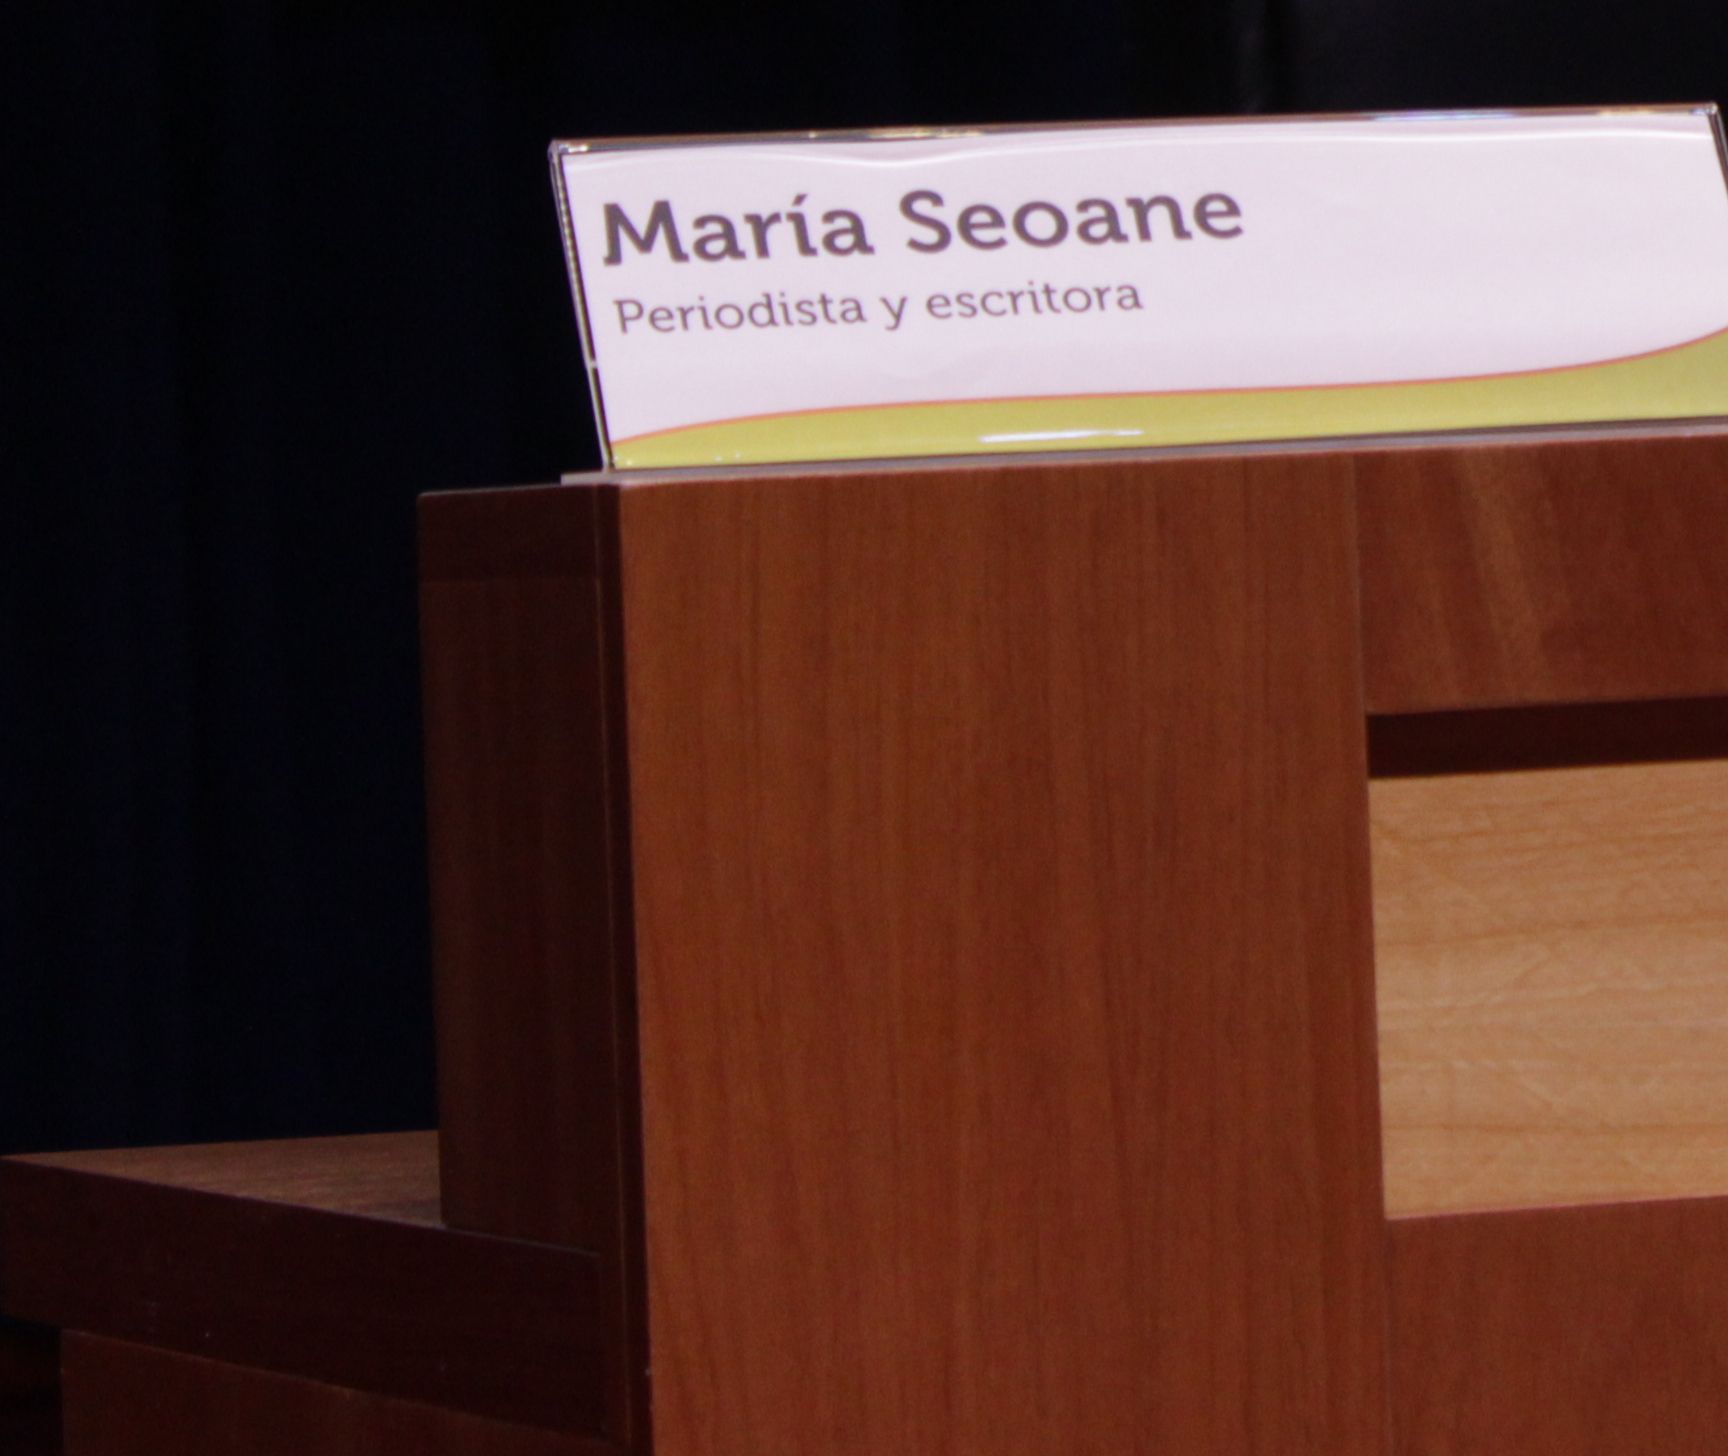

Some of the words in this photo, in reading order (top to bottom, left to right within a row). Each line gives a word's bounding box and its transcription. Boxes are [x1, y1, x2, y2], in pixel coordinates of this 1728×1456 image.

[603, 193, 875, 266] María
[899, 189, 1243, 254] Seoane
[613, 292, 867, 334] Periodista
[880, 296, 909, 331] y
[925, 281, 1144, 320] escritora
